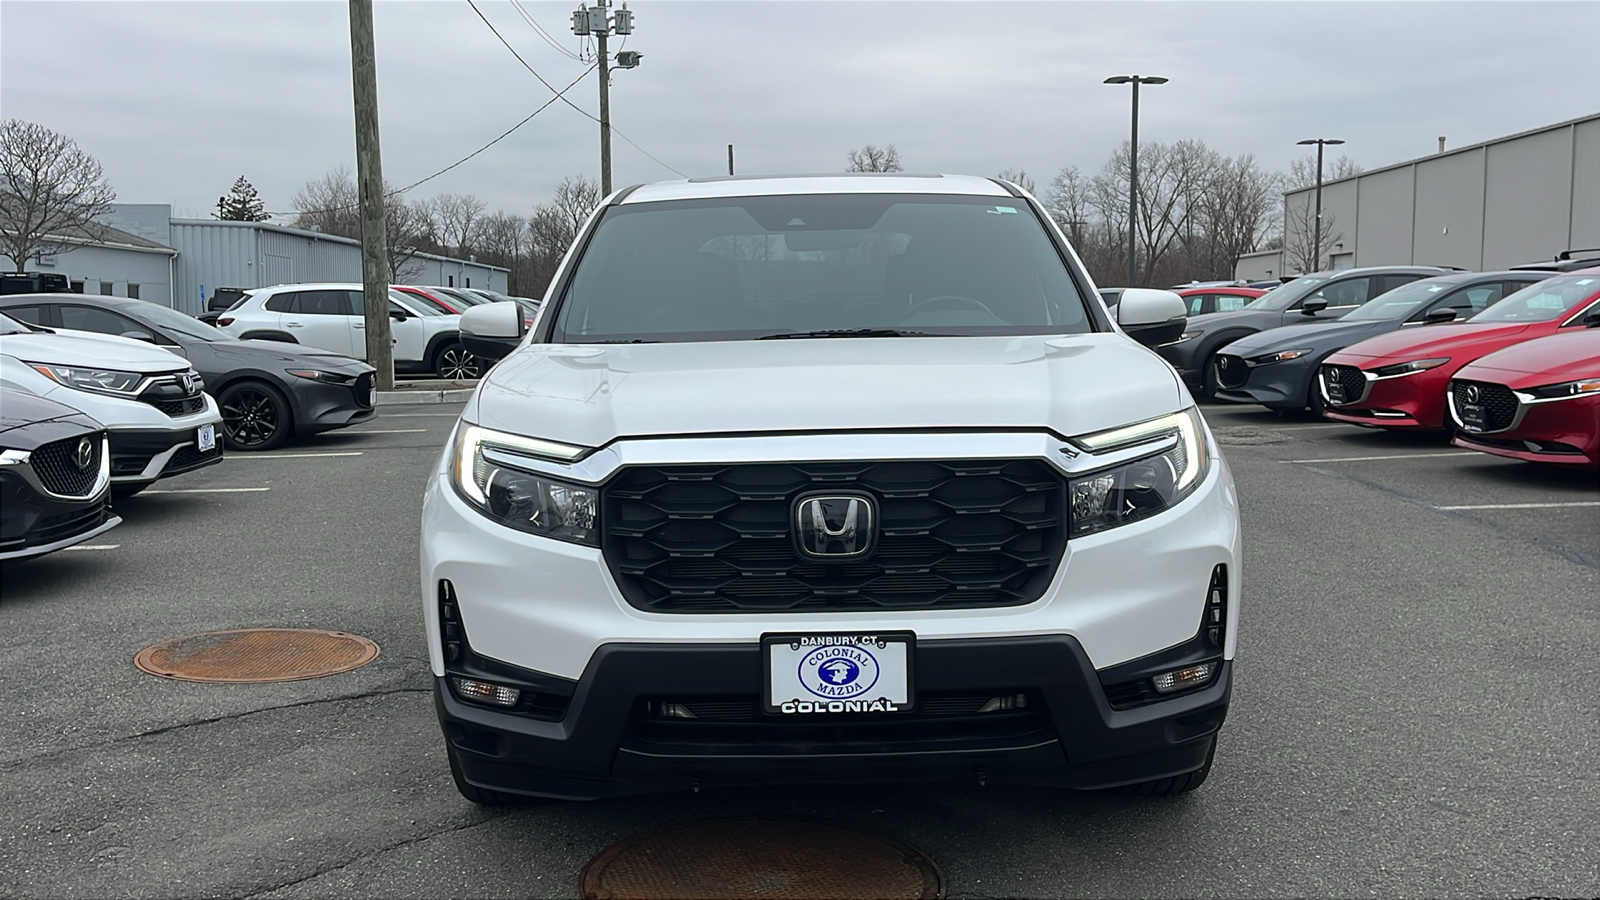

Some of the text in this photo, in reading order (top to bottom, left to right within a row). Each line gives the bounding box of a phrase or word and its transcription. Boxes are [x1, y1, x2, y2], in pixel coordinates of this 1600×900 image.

[800, 636, 878, 646] DANBURY, CT
[808, 648, 870, 667] COLONIAL
[816, 682, 864, 696] MAZDA
[781, 700, 898, 714] COLONIAL
